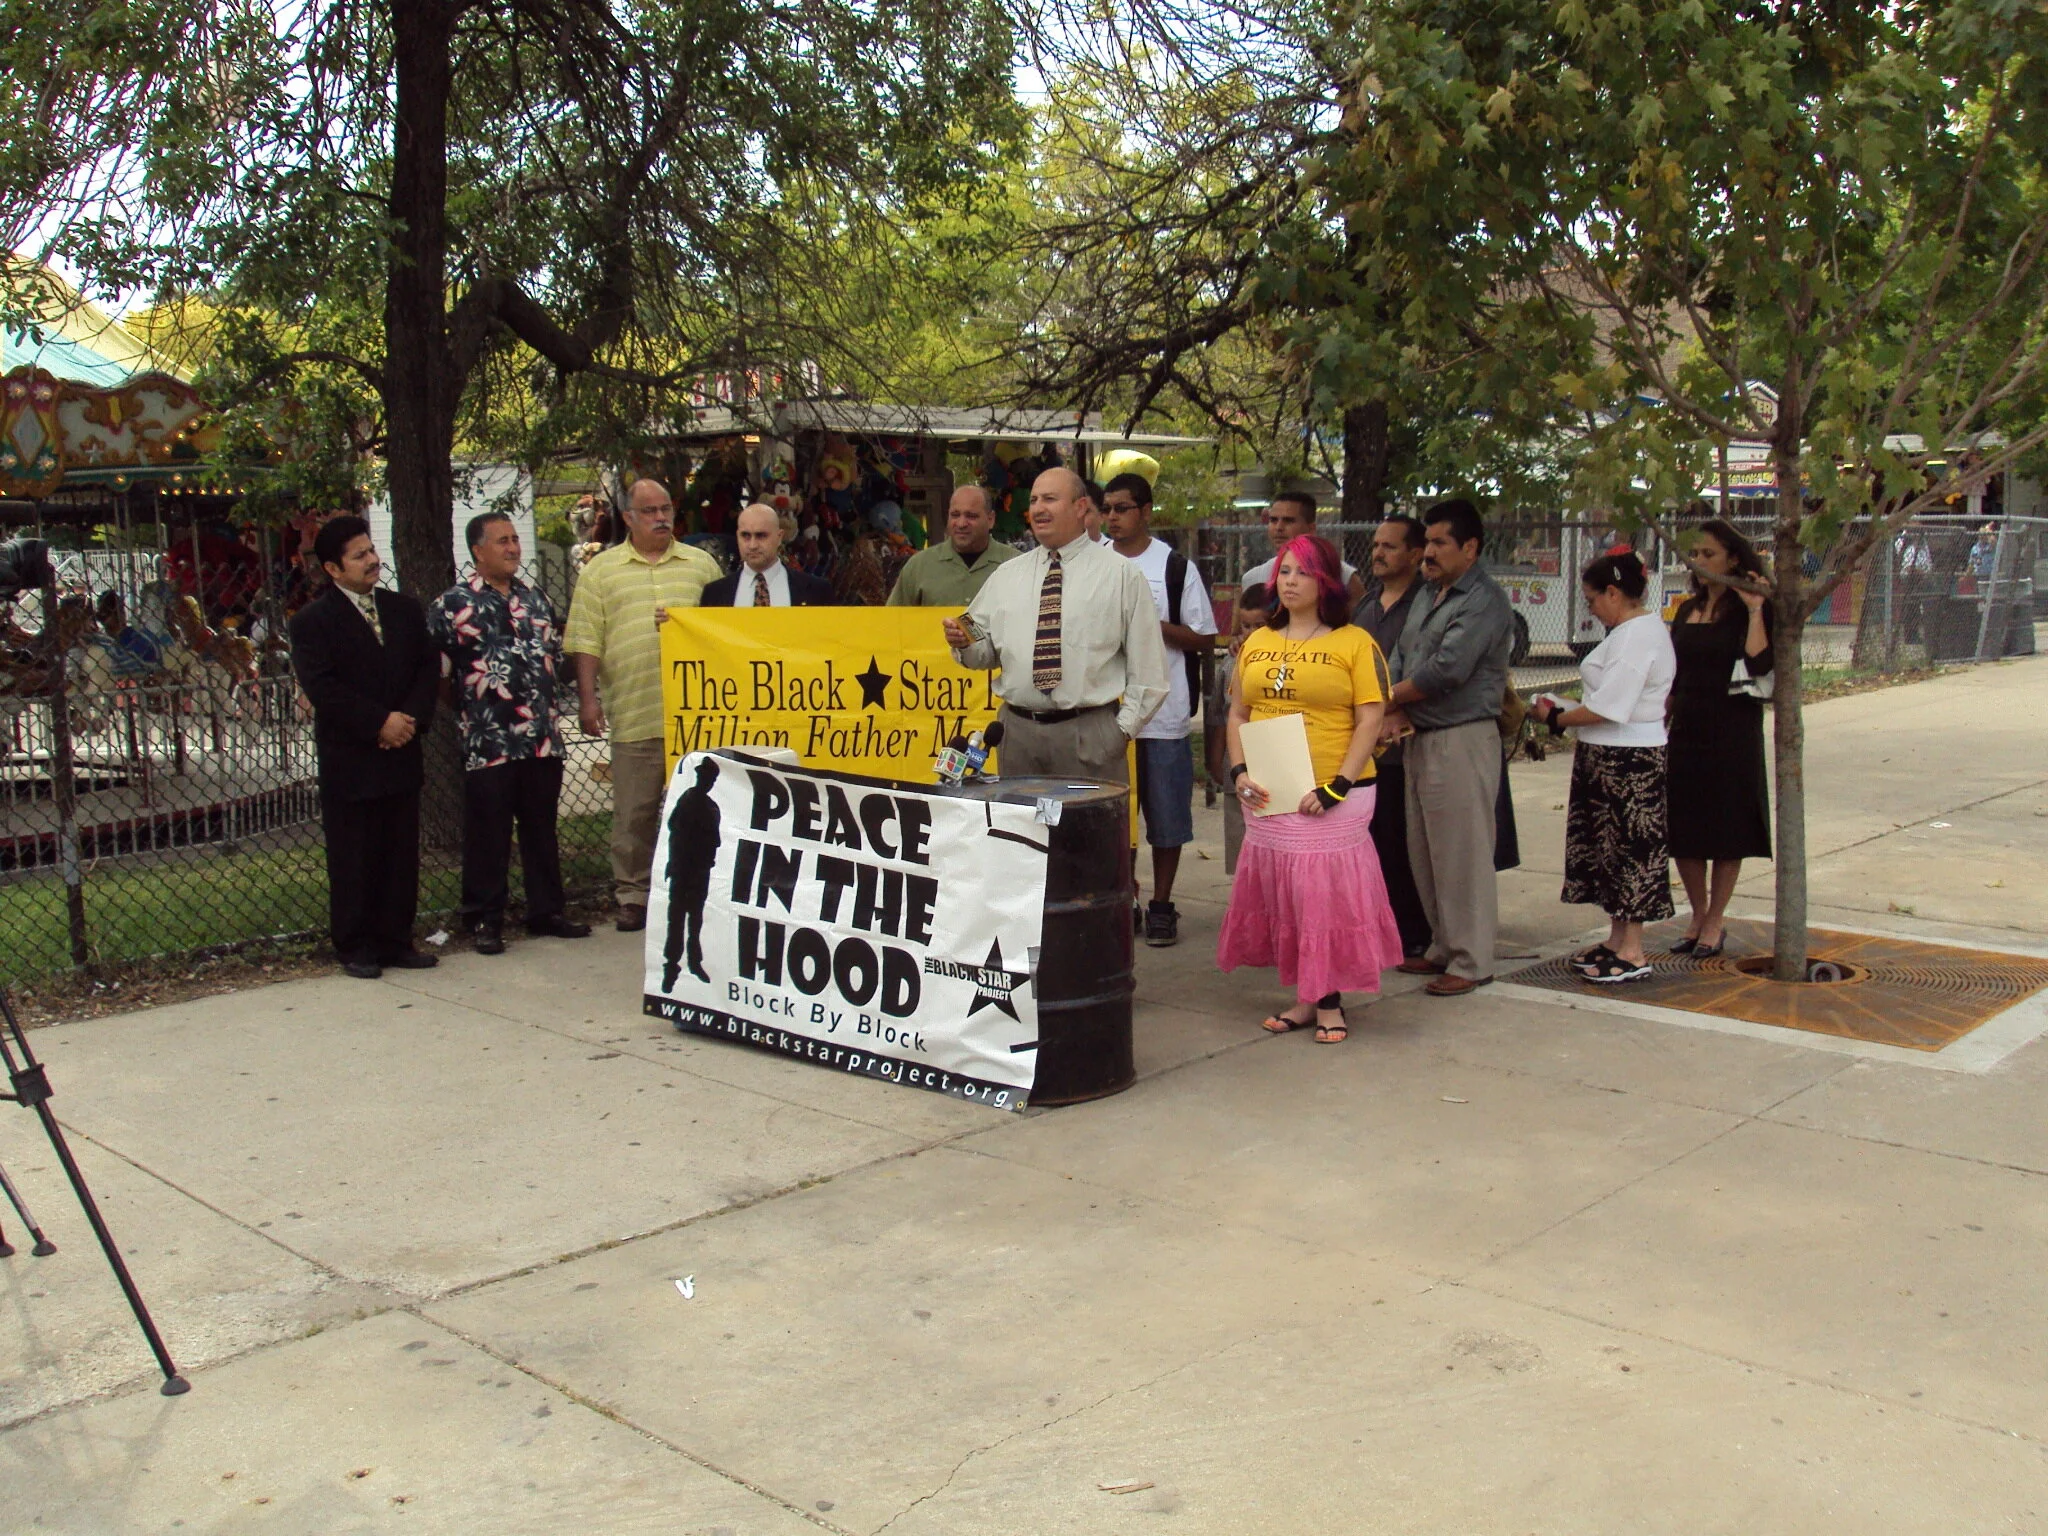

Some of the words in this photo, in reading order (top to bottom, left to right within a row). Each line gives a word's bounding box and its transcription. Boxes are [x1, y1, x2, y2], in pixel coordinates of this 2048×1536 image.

[672, 660, 738, 711] The
[750, 659, 847, 711] Black
[900, 658, 973, 711] Star
[1263, 687, 1297, 701] DIE
[1265, 667, 1295, 681] OR
[670, 715, 790, 756] Million
[804, 714, 919, 758] Father
[746, 769, 932, 866] PEACE
[730, 838, 803, 916] IN
[815, 854, 939, 946] THE
[737, 915, 921, 1019] HOOD
[924, 955, 934, 974] THE
[933, 958, 977, 983] BLACK
[977, 967, 1012, 990] STAR
[728, 981, 796, 1018] Block
[810, 1003, 842, 1033] By
[857, 1013, 928, 1053] Block
[977, 986, 1010, 1001] PROJECT
[660, 1002, 1010, 1109] www.blackstarproject.org
